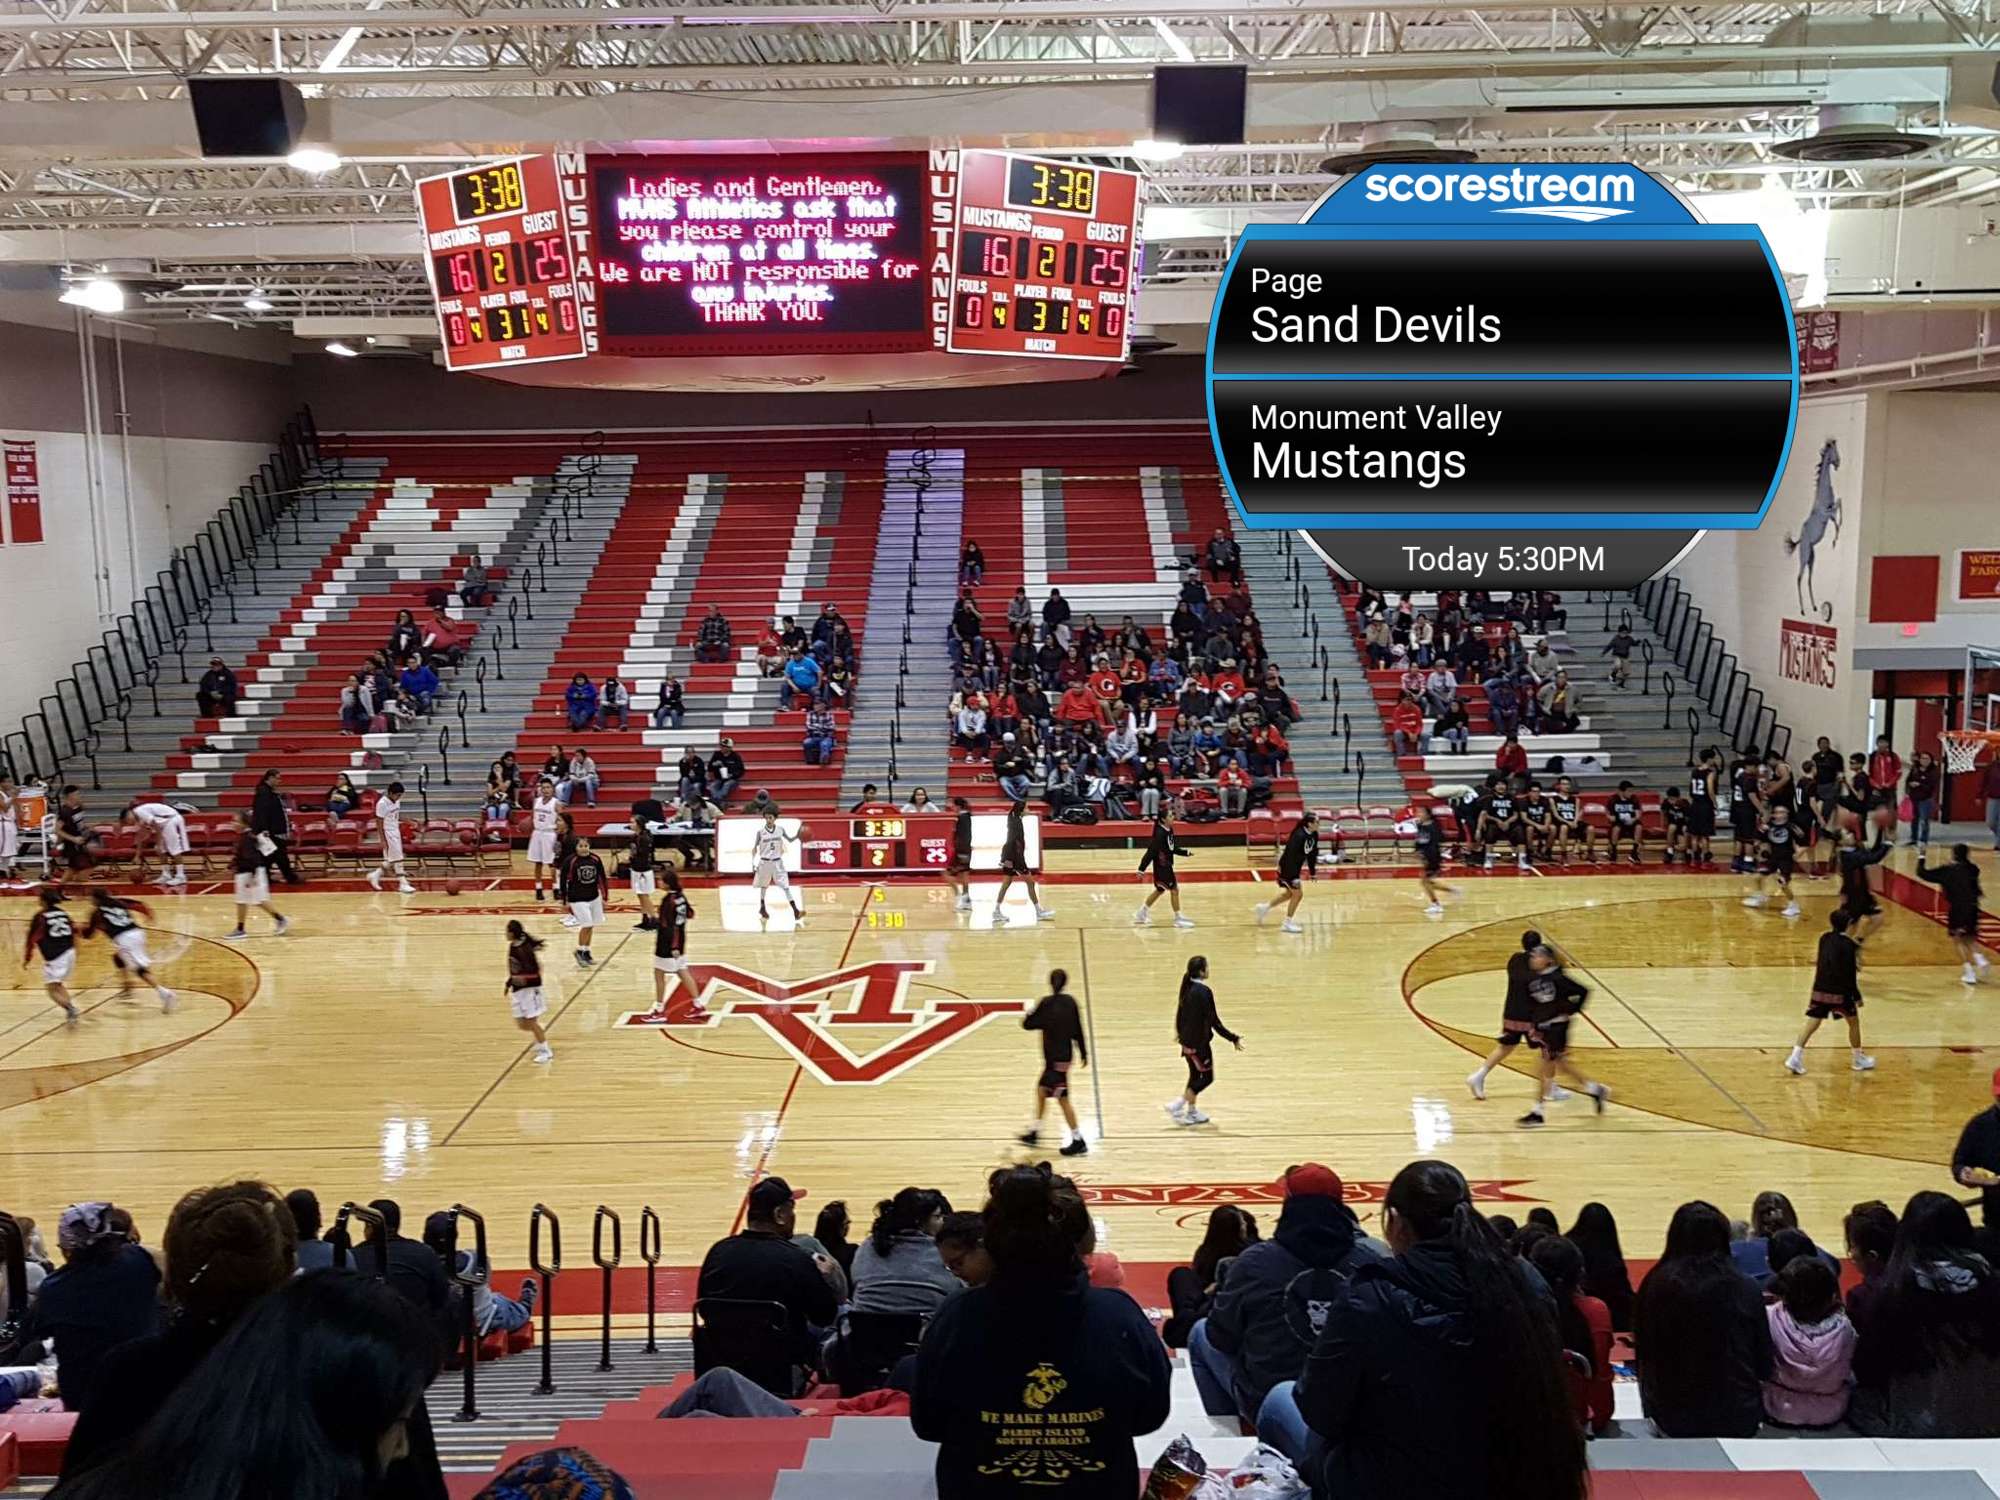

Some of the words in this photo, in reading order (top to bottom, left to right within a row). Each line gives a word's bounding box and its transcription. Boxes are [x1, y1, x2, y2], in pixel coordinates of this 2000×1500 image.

[468, 166, 521, 215] 3:38
[629, 178, 702, 198] Ladies
[713, 177, 755, 197] and
[1031, 165, 1092, 211] 3:38
[687, 197, 784, 219] Athletics
[793, 197, 836, 218] ask
[847, 195, 896, 217] that
[522, 210, 558, 234] GUEST
[619, 224, 658, 240] you
[670, 220, 743, 239] please
[753, 219, 833, 238] control
[844, 223, 896, 238] your
[963, 206, 1032, 233] MUSTANGS
[1086, 221, 1127, 242] GUEST
[534, 238, 567, 280] 25
[556, 154, 599, 352] MUSTANGS
[642, 241, 730, 262] children
[739, 240, 768, 260] at
[777, 239, 805, 260] all
[929, 151, 958, 347] MUSTANGS
[983, 237, 1009, 276] 16
[1040, 246, 1055, 276] 2
[450, 254, 474, 292] 16
[492, 252, 507, 283] 2
[599, 262, 628, 281] We
[640, 266, 682, 281] are
[693, 262, 733, 281] NOT
[745, 259, 869, 280] responsible
[881, 259, 919, 279] for
[1091, 248, 1125, 286] 25
[691, 284, 735, 303] any
[957, 279, 988, 294] FOULS
[1014, 284, 1048, 299] PLAYER
[702, 302, 765, 322] THANK
[777, 302, 823, 321] YOU.
[1003, 1413, 1043, 1424] MAKE
[1048, 1408, 1105, 1424] MARINES
[995, 1437, 1034, 1445] SOUTH
[1035, 1436, 1091, 1445] CAROLINA
[1045, 1428, 1086, 1437] ISLAND
